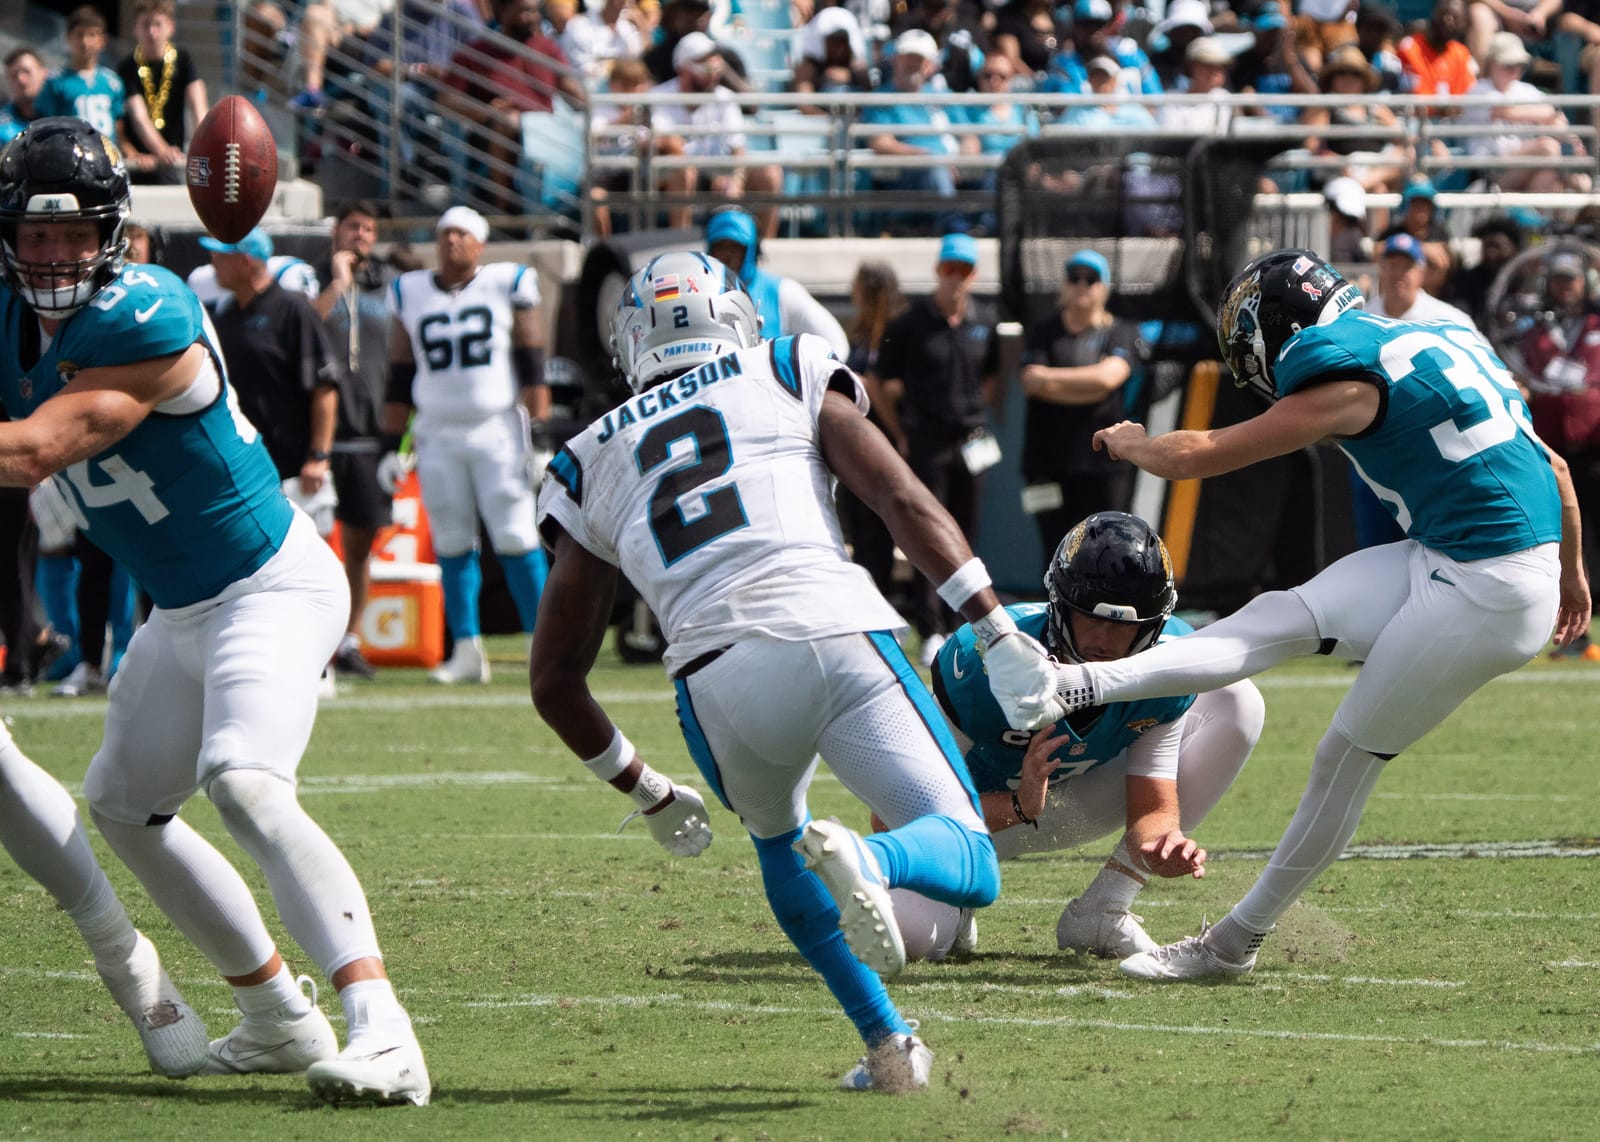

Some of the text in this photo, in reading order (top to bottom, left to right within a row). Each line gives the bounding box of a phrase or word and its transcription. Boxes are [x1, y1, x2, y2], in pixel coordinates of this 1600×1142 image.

[418, 306, 494, 371] 62
[673, 305, 689, 328] 2
[663, 341, 713, 356] PANTHERS
[595, 352, 743, 443] JACKSON
[634, 404, 748, 568] 2
[358, 597, 408, 649] G
